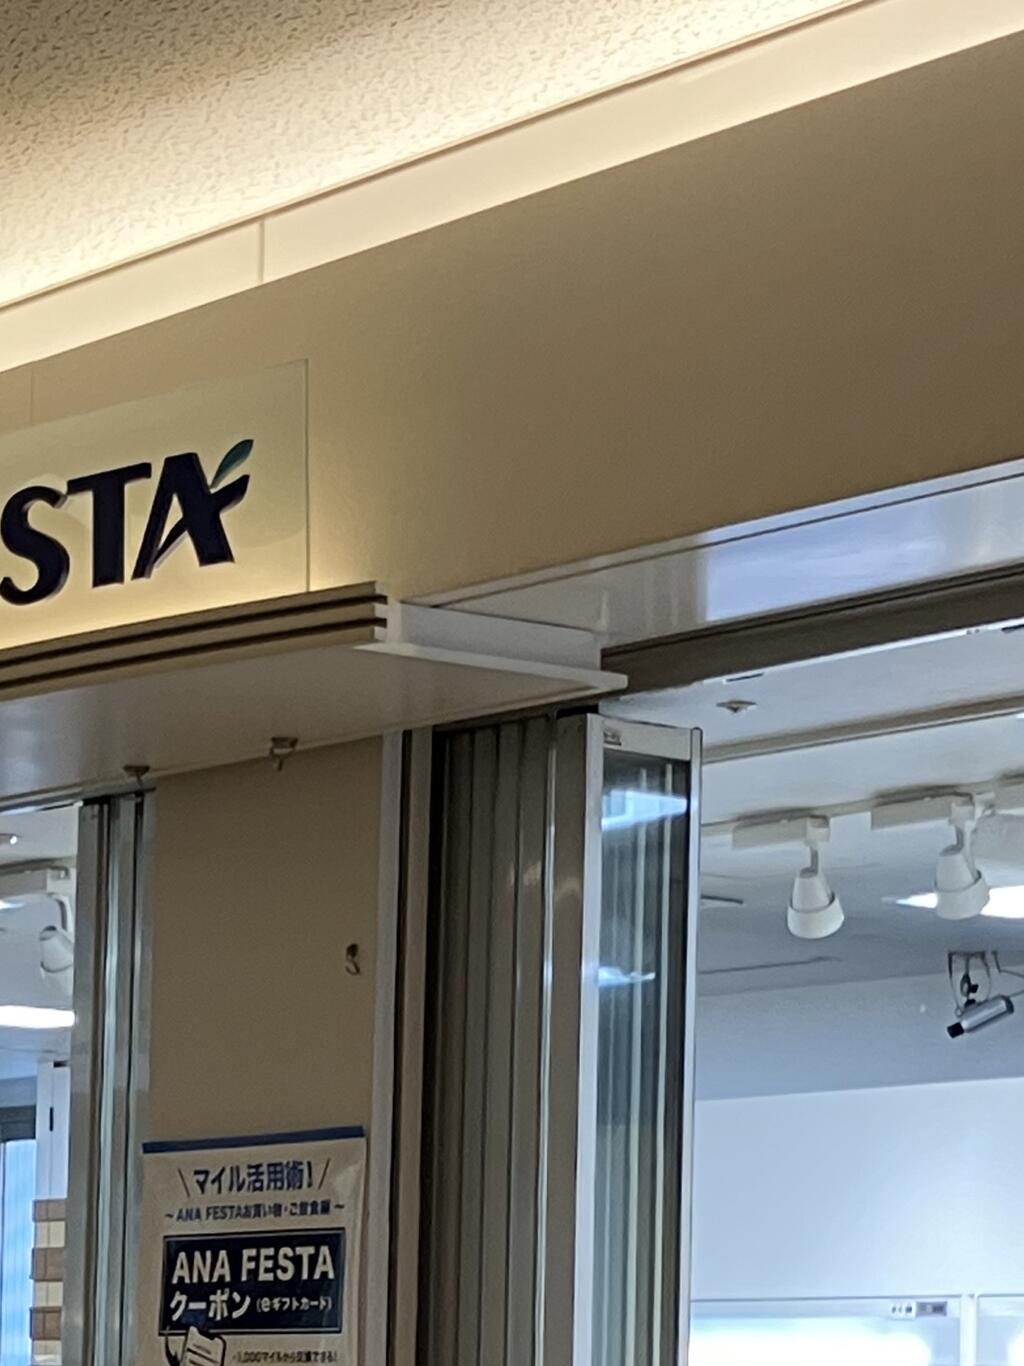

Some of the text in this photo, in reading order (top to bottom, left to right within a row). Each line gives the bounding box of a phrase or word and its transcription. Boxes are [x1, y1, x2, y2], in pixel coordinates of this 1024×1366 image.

[193, 1160, 313, 1195] マイル活用術!
[171, 1245, 335, 1284] ANA FESTA
[169, 1288, 250, 1321] クーポン
